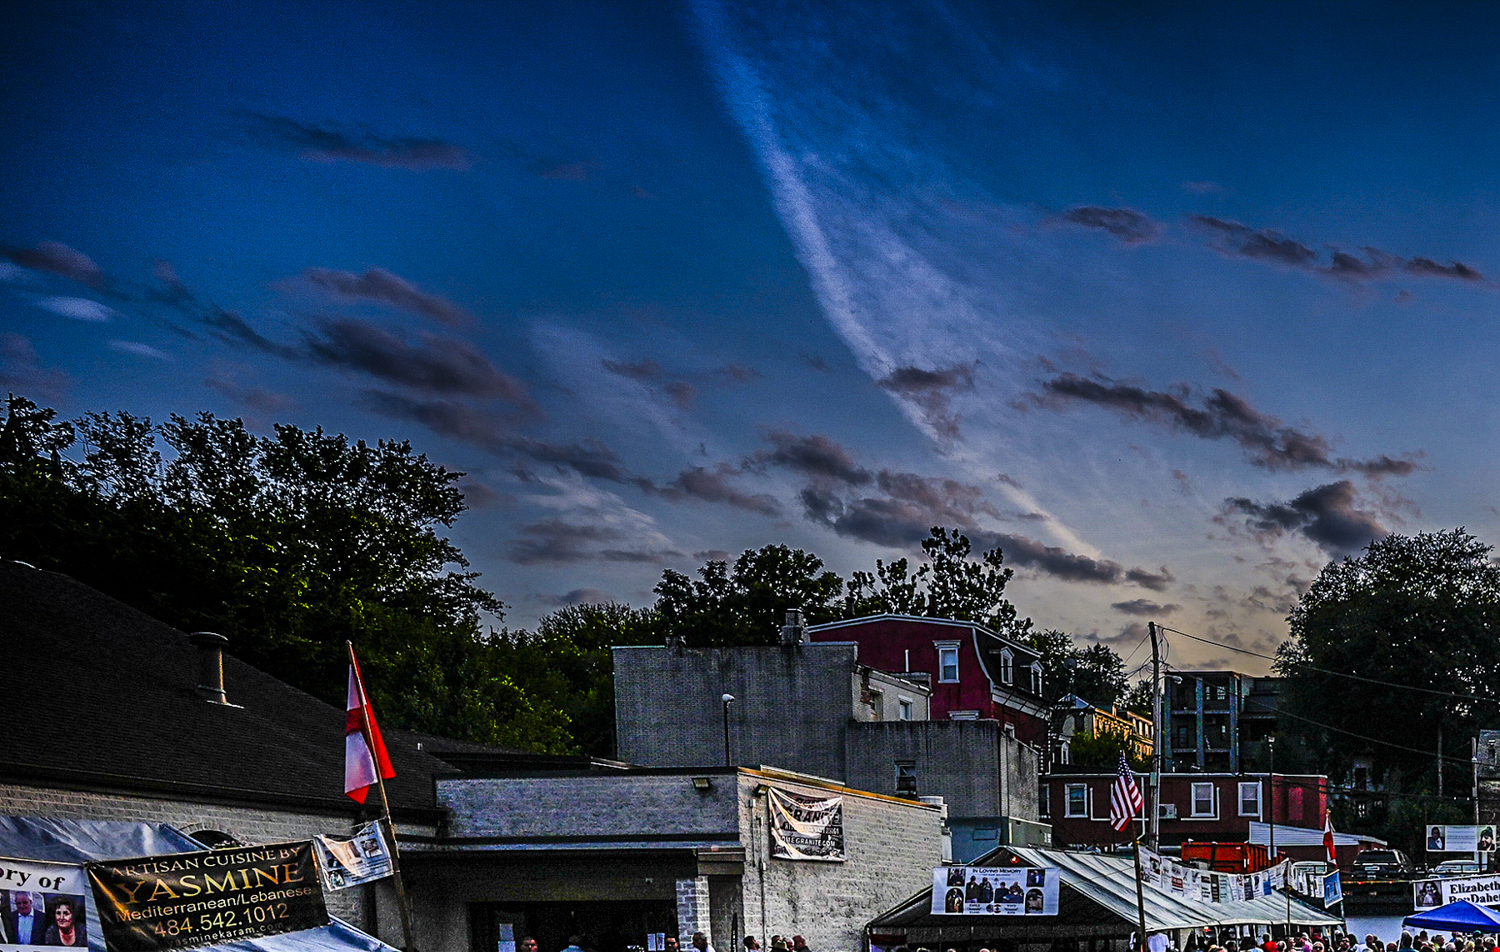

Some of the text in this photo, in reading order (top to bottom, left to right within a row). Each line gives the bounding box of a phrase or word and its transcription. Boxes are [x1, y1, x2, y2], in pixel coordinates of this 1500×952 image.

[111, 847, 302, 877] ARTISAN CUISINE BY
[39, 876, 65, 891] of
[116, 861, 304, 904] YASMINE
[115, 886, 312, 922] Mediterranean/Lebanese
[154, 902, 290, 937] 484.542.1012
